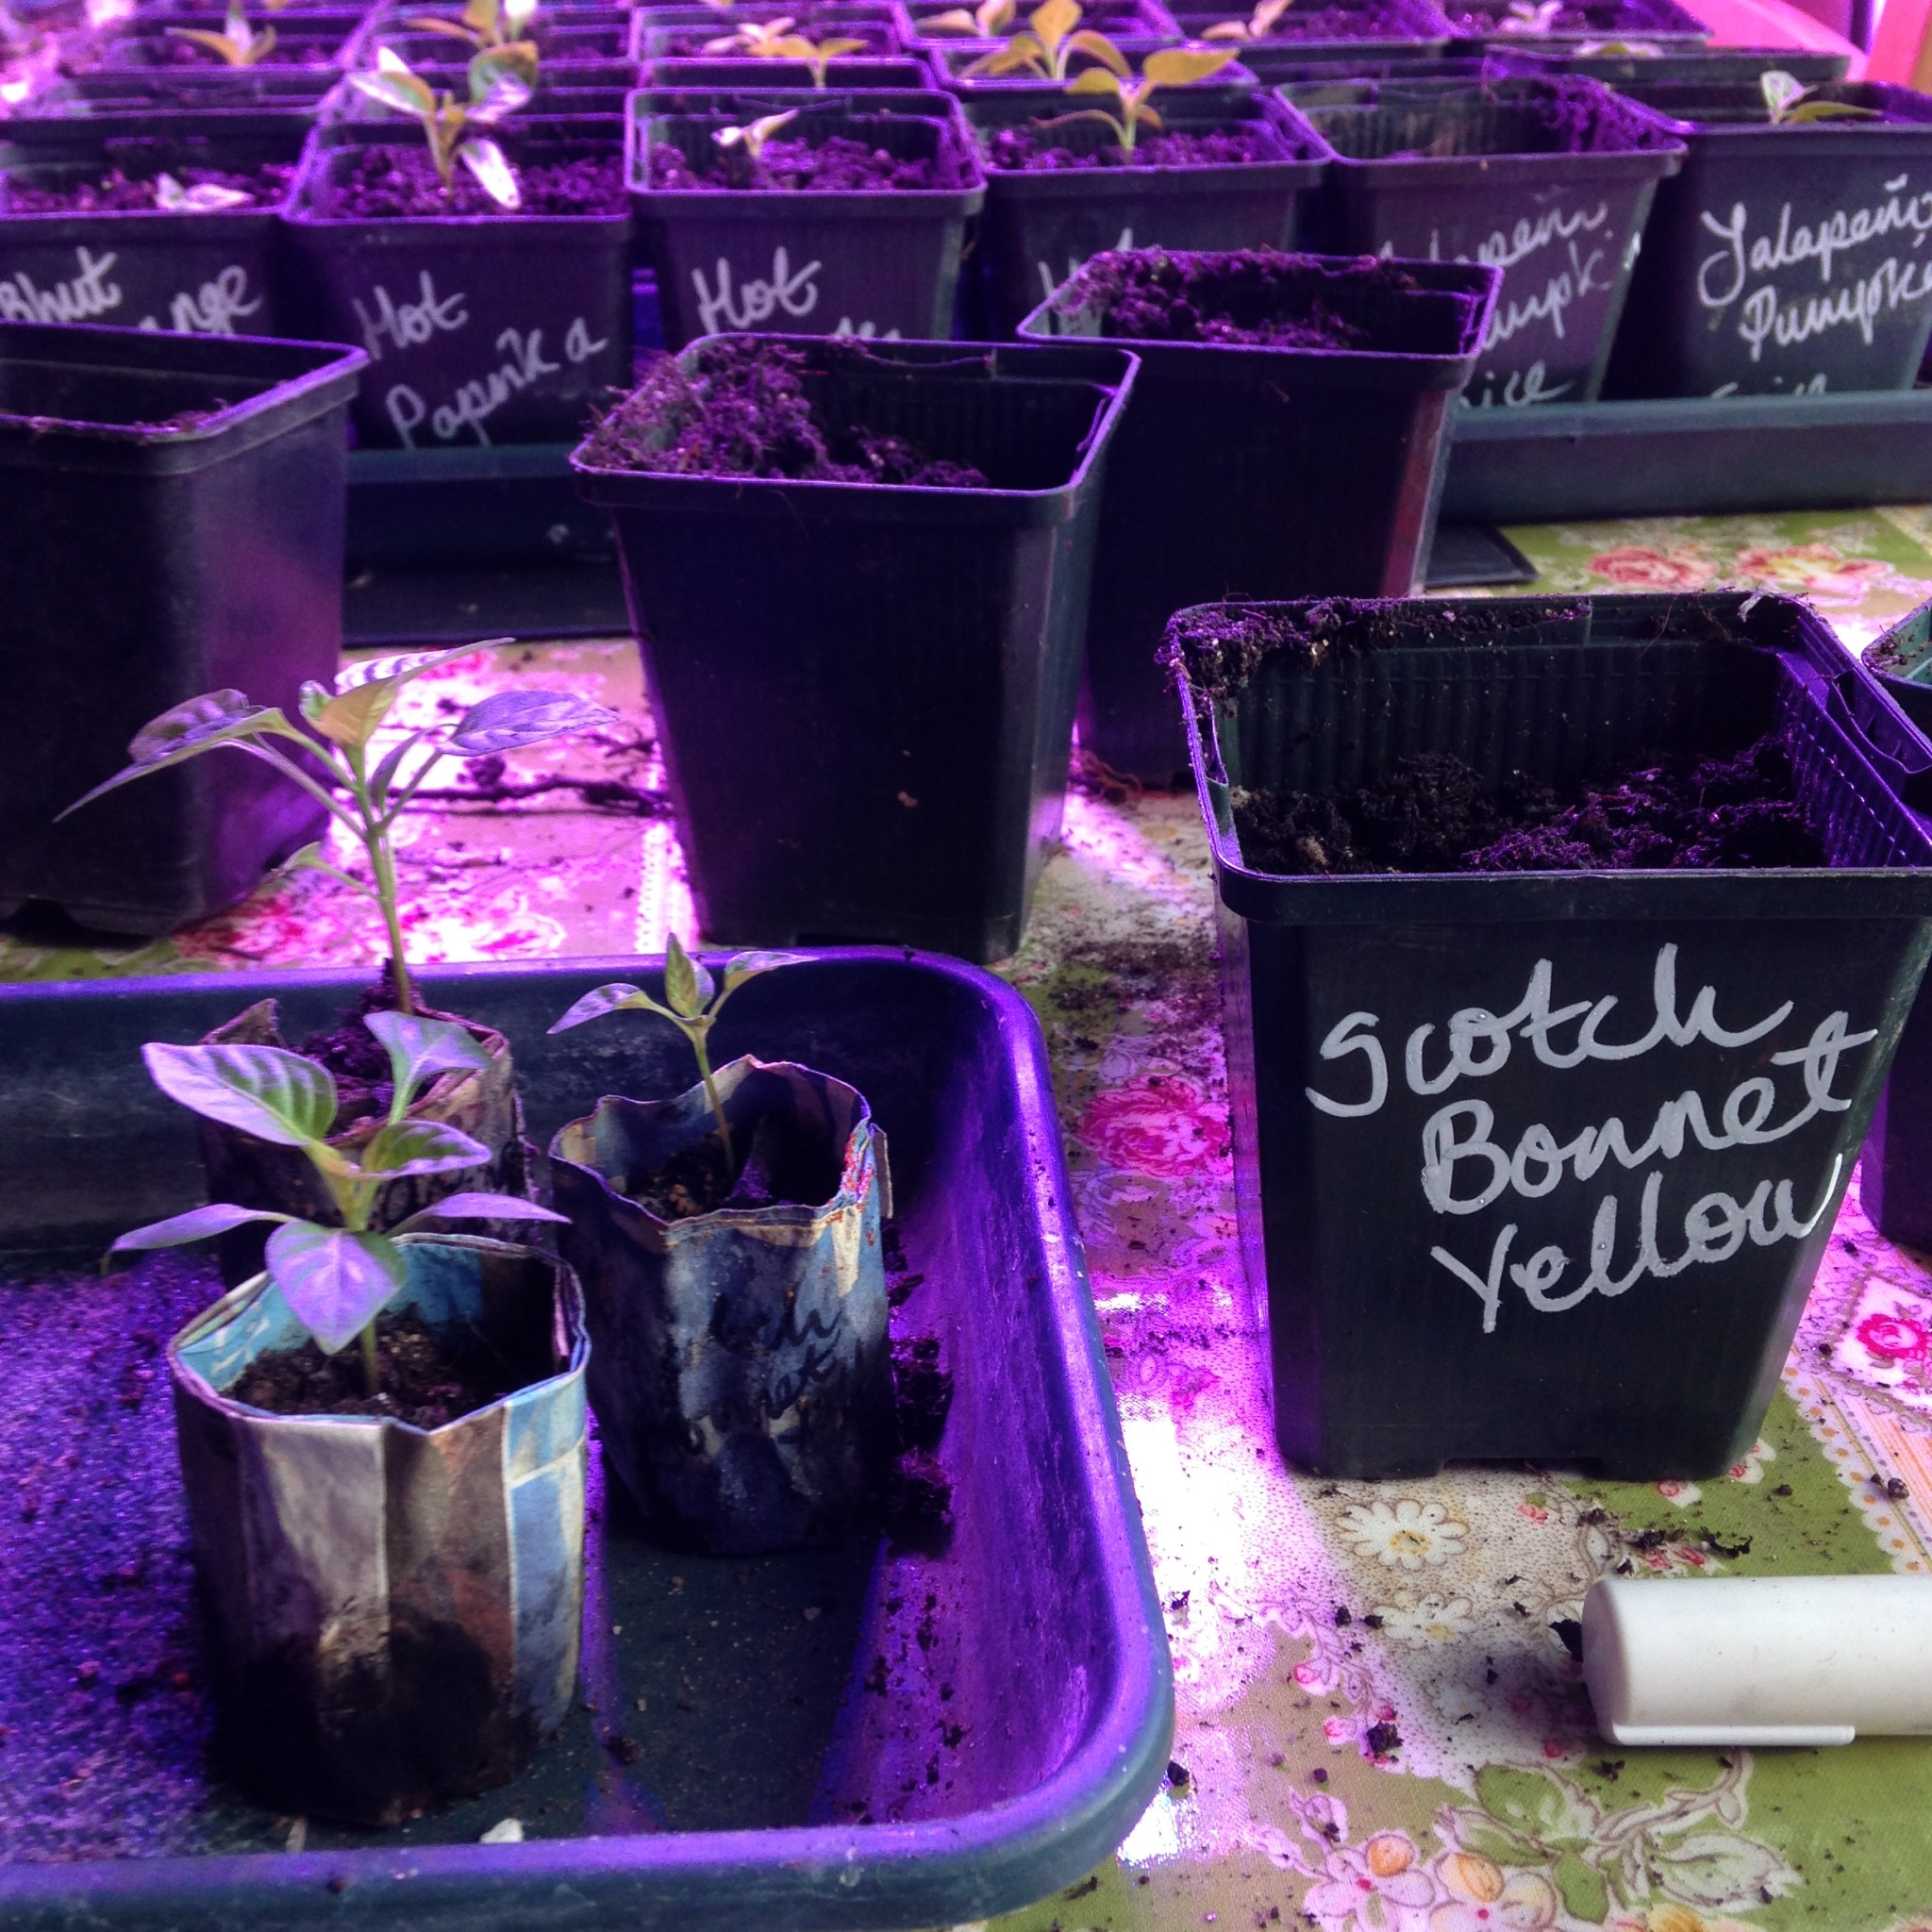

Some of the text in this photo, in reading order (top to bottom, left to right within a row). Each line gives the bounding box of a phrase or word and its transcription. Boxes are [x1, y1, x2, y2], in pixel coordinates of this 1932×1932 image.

[352, 270, 469, 361] Hot
[691, 246, 823, 336] Hot
[385, 317, 609, 450] Paprika
[1306, 942, 1794, 1118] Scotch
[1421, 1010, 1878, 1215] Bonnet
[1430, 1153, 1844, 1334] Yellow
